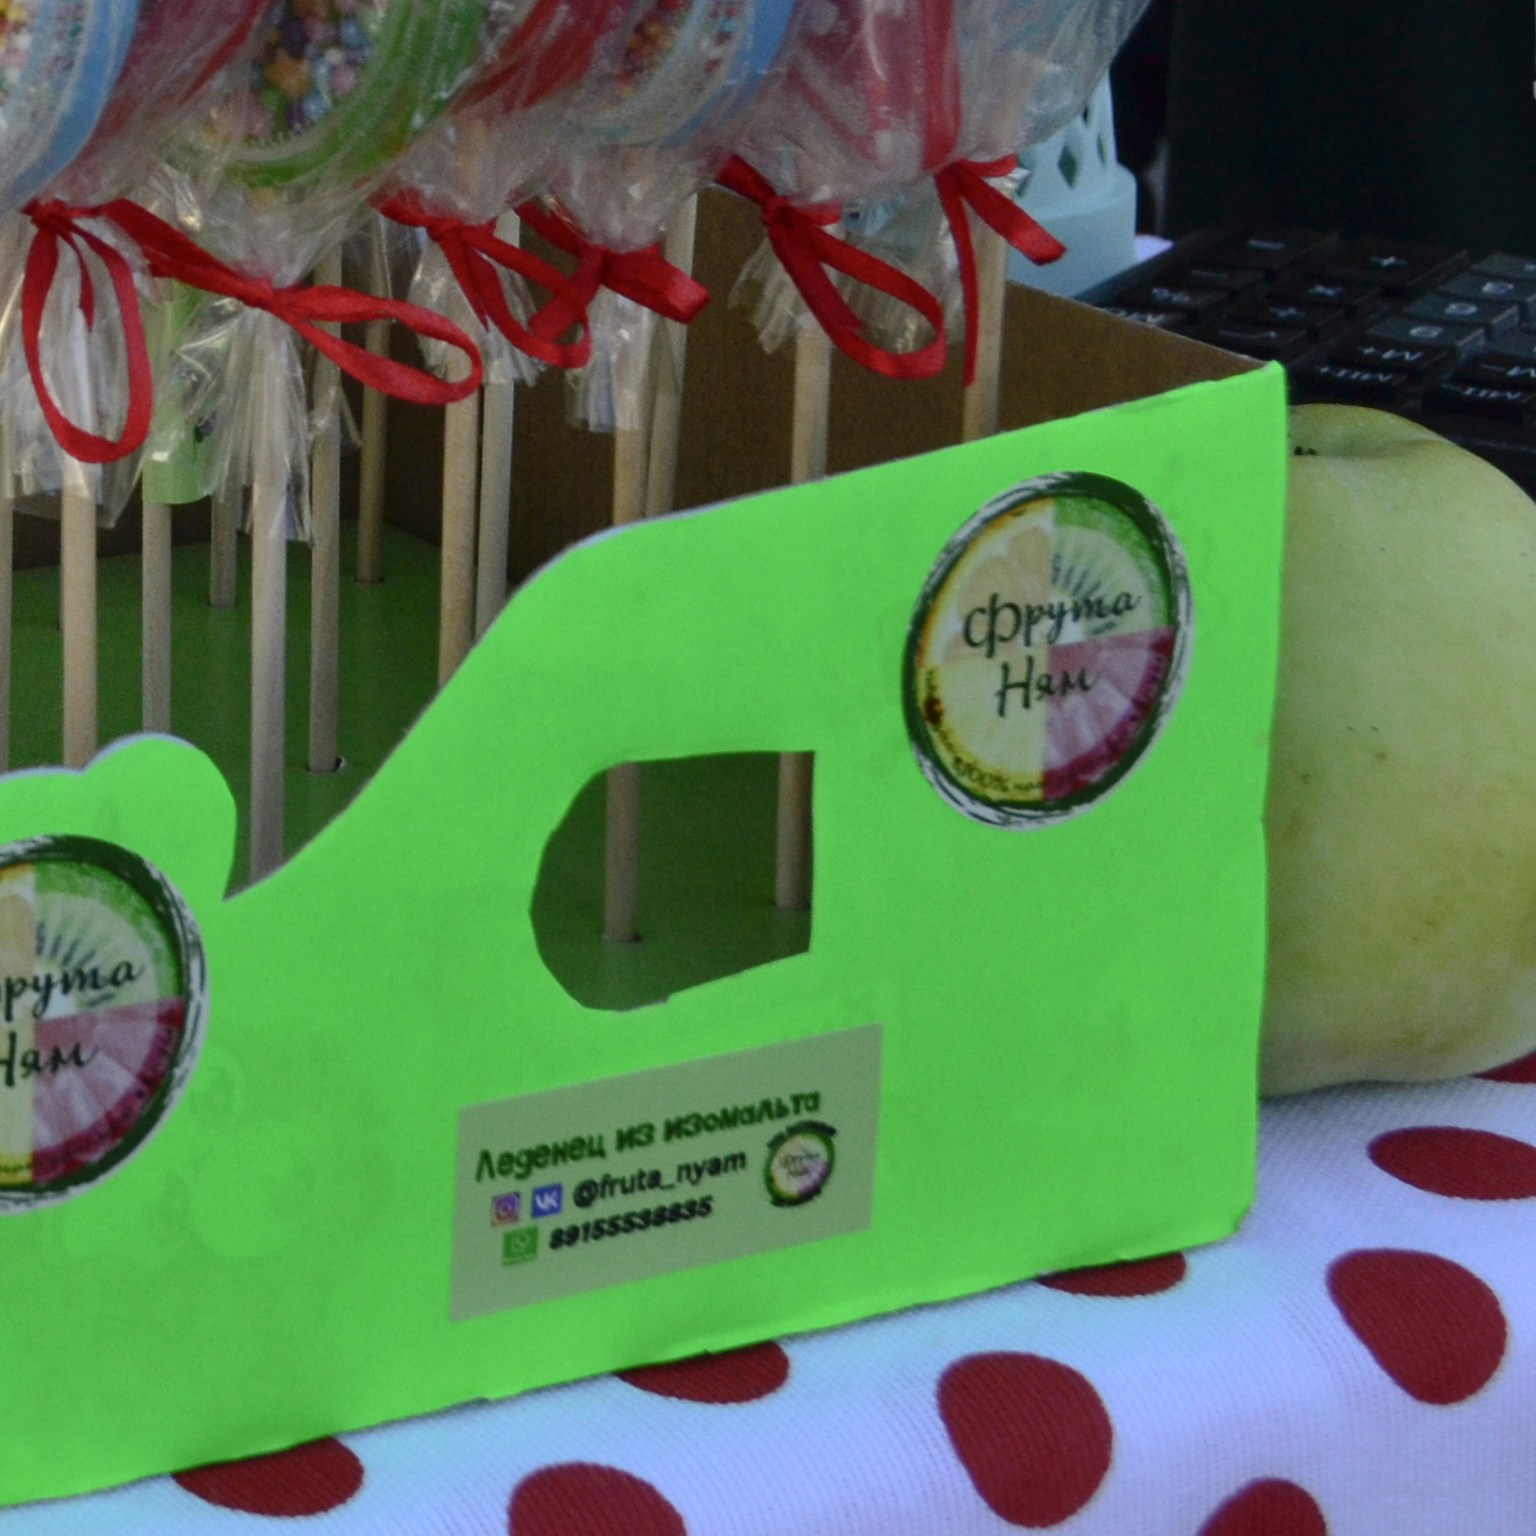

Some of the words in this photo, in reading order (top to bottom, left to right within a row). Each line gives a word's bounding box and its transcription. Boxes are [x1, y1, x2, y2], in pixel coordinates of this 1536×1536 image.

[962, 592, 1139, 659] Фрута
[995, 654, 1098, 718] Ням
[474, 1132, 607, 1183] Леденец
[614, 1121, 657, 1152] из
[662, 1090, 821, 1144] изомальта
[572, 1149, 748, 1209] @fruta_nyam
